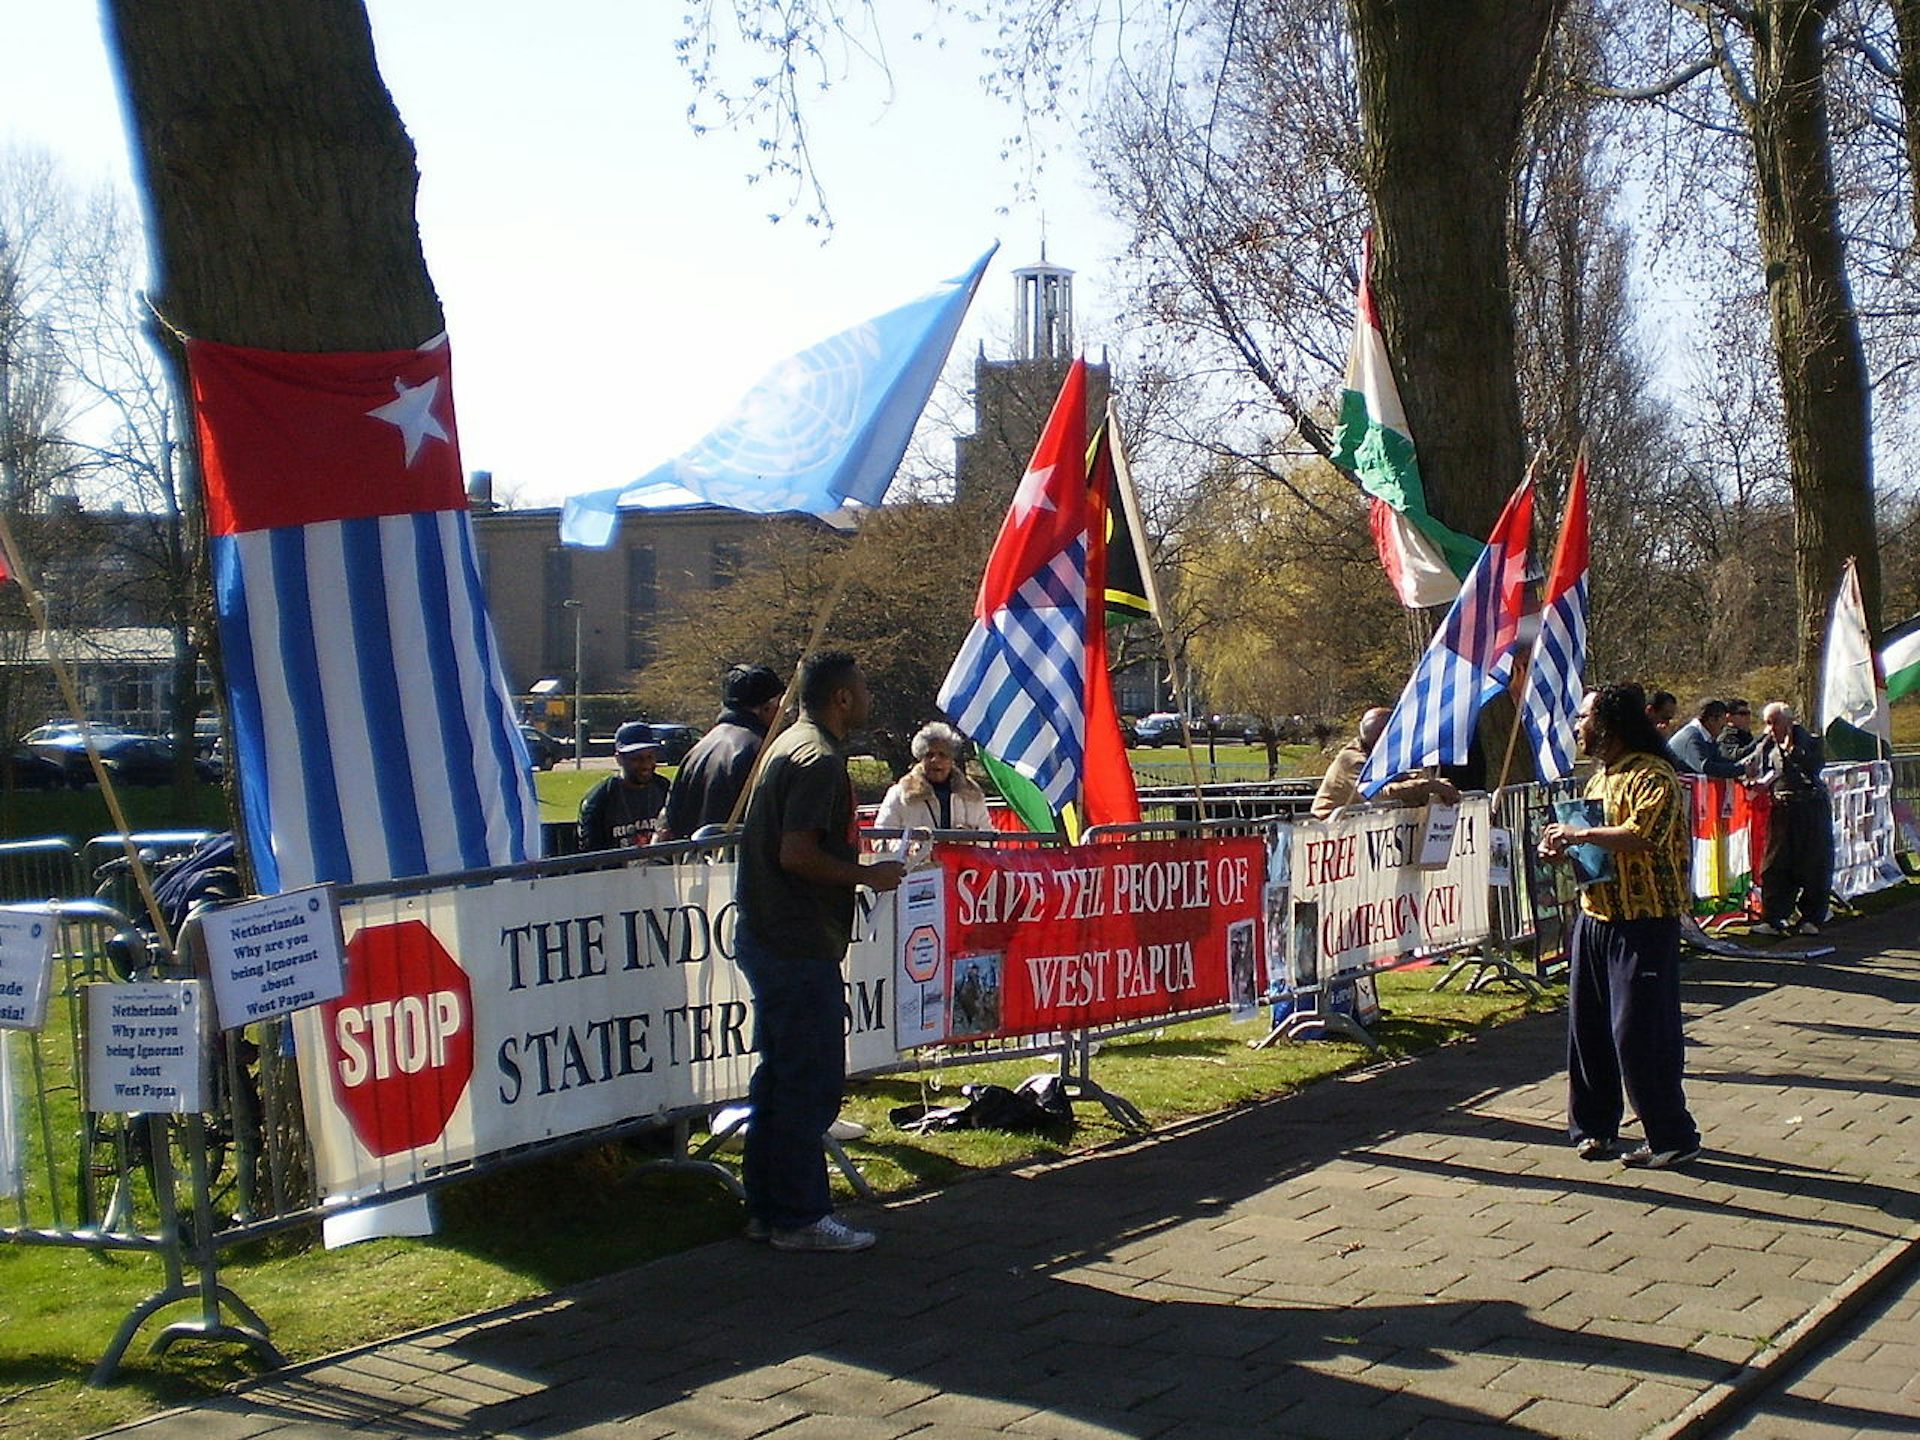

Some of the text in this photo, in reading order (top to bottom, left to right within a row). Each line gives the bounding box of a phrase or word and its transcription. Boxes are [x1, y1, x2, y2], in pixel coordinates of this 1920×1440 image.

[1306, 834, 1357, 888] FREE
[1366, 823, 1419, 873] WEST
[957, 857, 1249, 926] SAVE THE PEOPLE OF
[230, 914, 305, 941] Netherlands
[234, 934, 308, 959] Why are you
[501, 915, 607, 991] THE
[231, 965, 264, 981] being
[261, 975, 295, 993] about
[1025, 941, 1196, 1010] WEST PAPUA
[112, 1004, 177, 1017] Netherlands
[246, 990, 314, 1015] West Papua
[112, 1025, 178, 1039] Why are you
[336, 990, 460, 1087] STOP
[106, 1045, 135, 1059] being
[498, 1014, 653, 1105] STATE
[129, 1064, 161, 1076] about
[114, 1084, 176, 1099] West Papua
